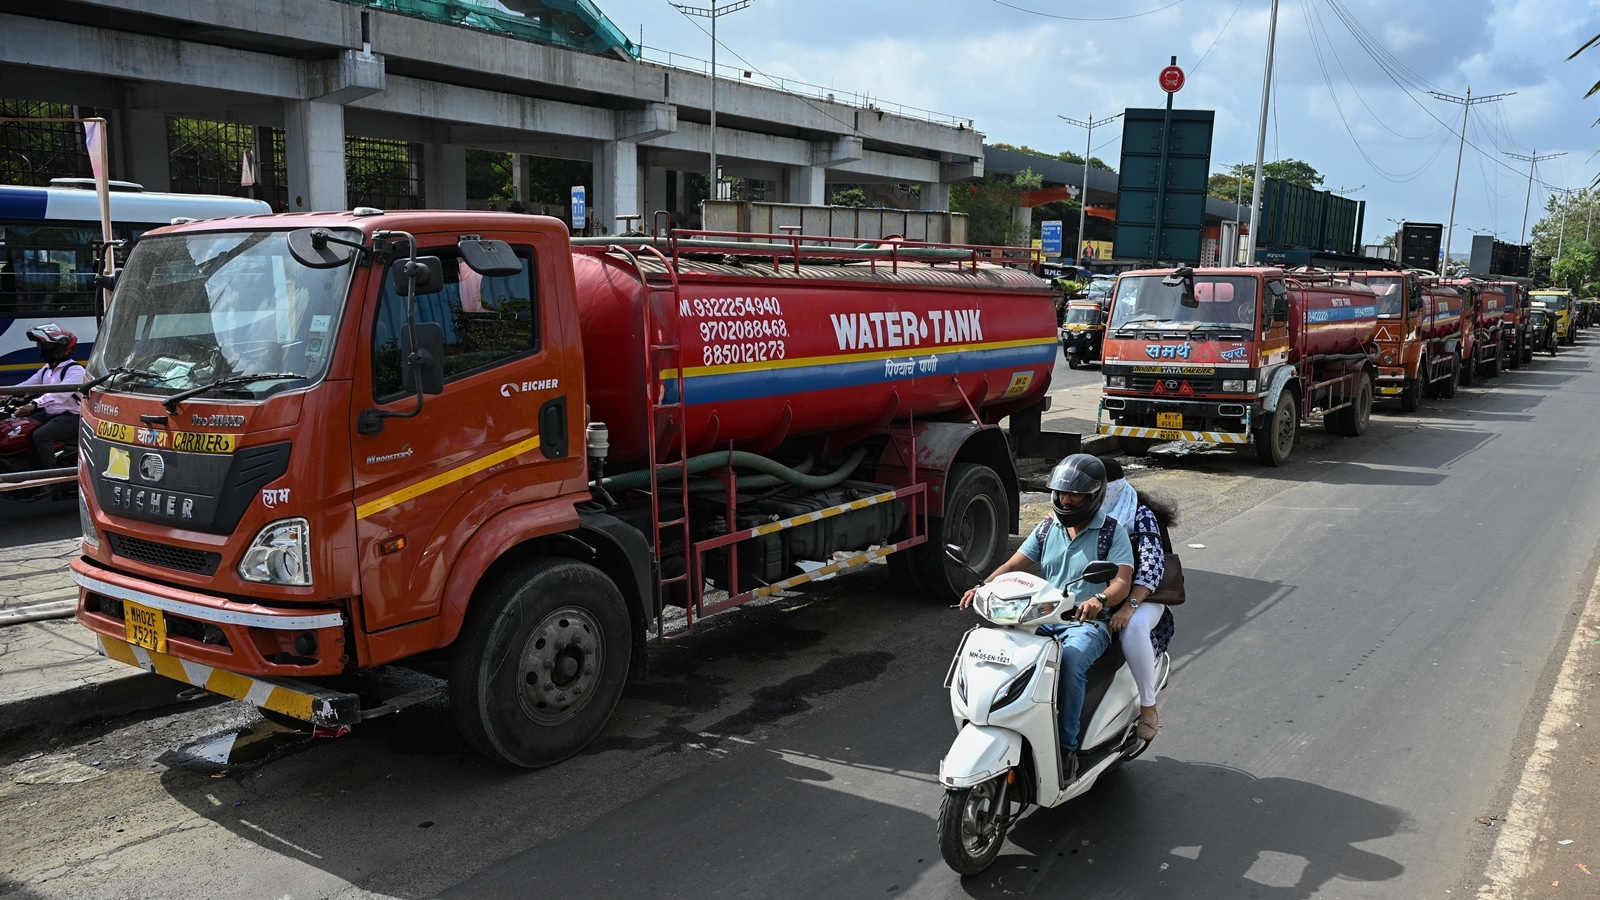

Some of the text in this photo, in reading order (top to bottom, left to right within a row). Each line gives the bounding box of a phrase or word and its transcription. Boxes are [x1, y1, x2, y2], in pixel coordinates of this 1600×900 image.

[830, 309, 983, 350] WATER TANK
[703, 340, 785, 366] 8850121273
[1146, 341, 1191, 359] समर्थ
[884, 354, 939, 378] पिण्याचे पाणी
[521, 378, 559, 392] EICHER
[191, 414, 208, 426] Pro
[98, 421, 127, 440] GOODS
[174, 433, 230, 451] CARRIER
[113, 487, 194, 519] EICHER
[262, 488, 290, 508] लाभ
[130, 606, 156, 627] MH02F
[133, 624, 158, 648] X5216
[968, 651, 1010, 664] MH-05-EN-1821
